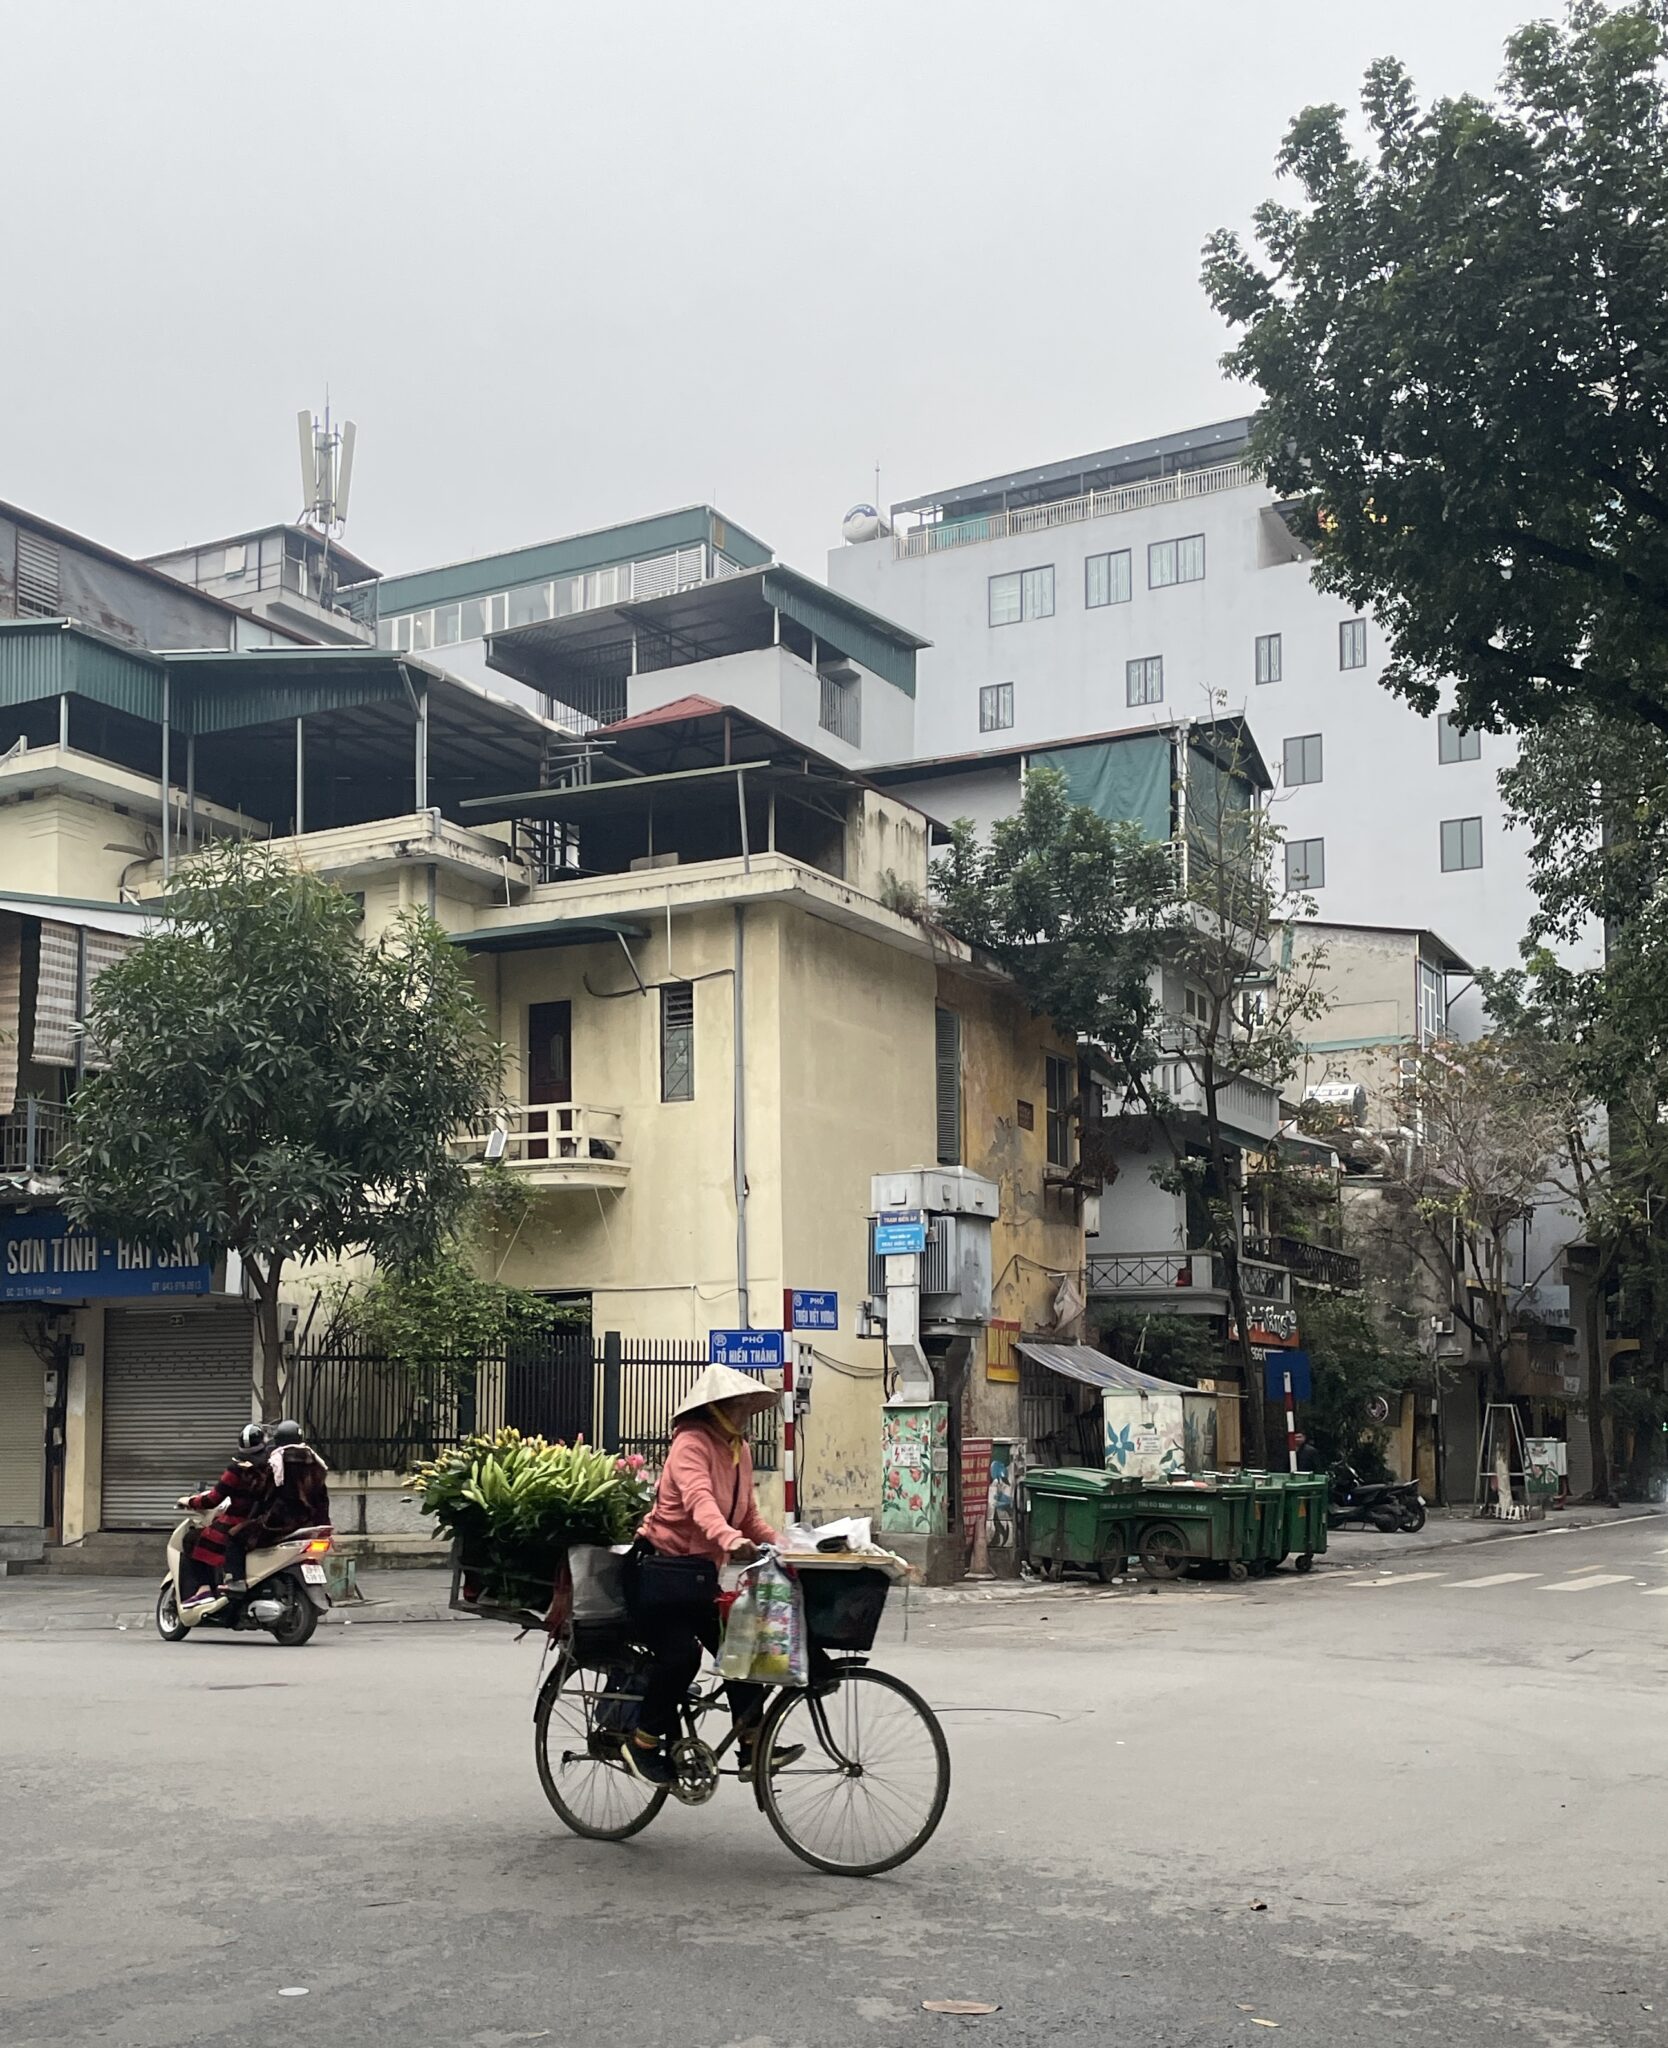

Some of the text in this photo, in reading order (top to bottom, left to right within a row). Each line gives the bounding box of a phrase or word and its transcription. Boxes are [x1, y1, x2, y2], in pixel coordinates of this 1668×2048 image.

[741, 1333, 764, 1344] PHỐ
[716, 1346, 778, 1363] TÔ HIẾN THÀNH
